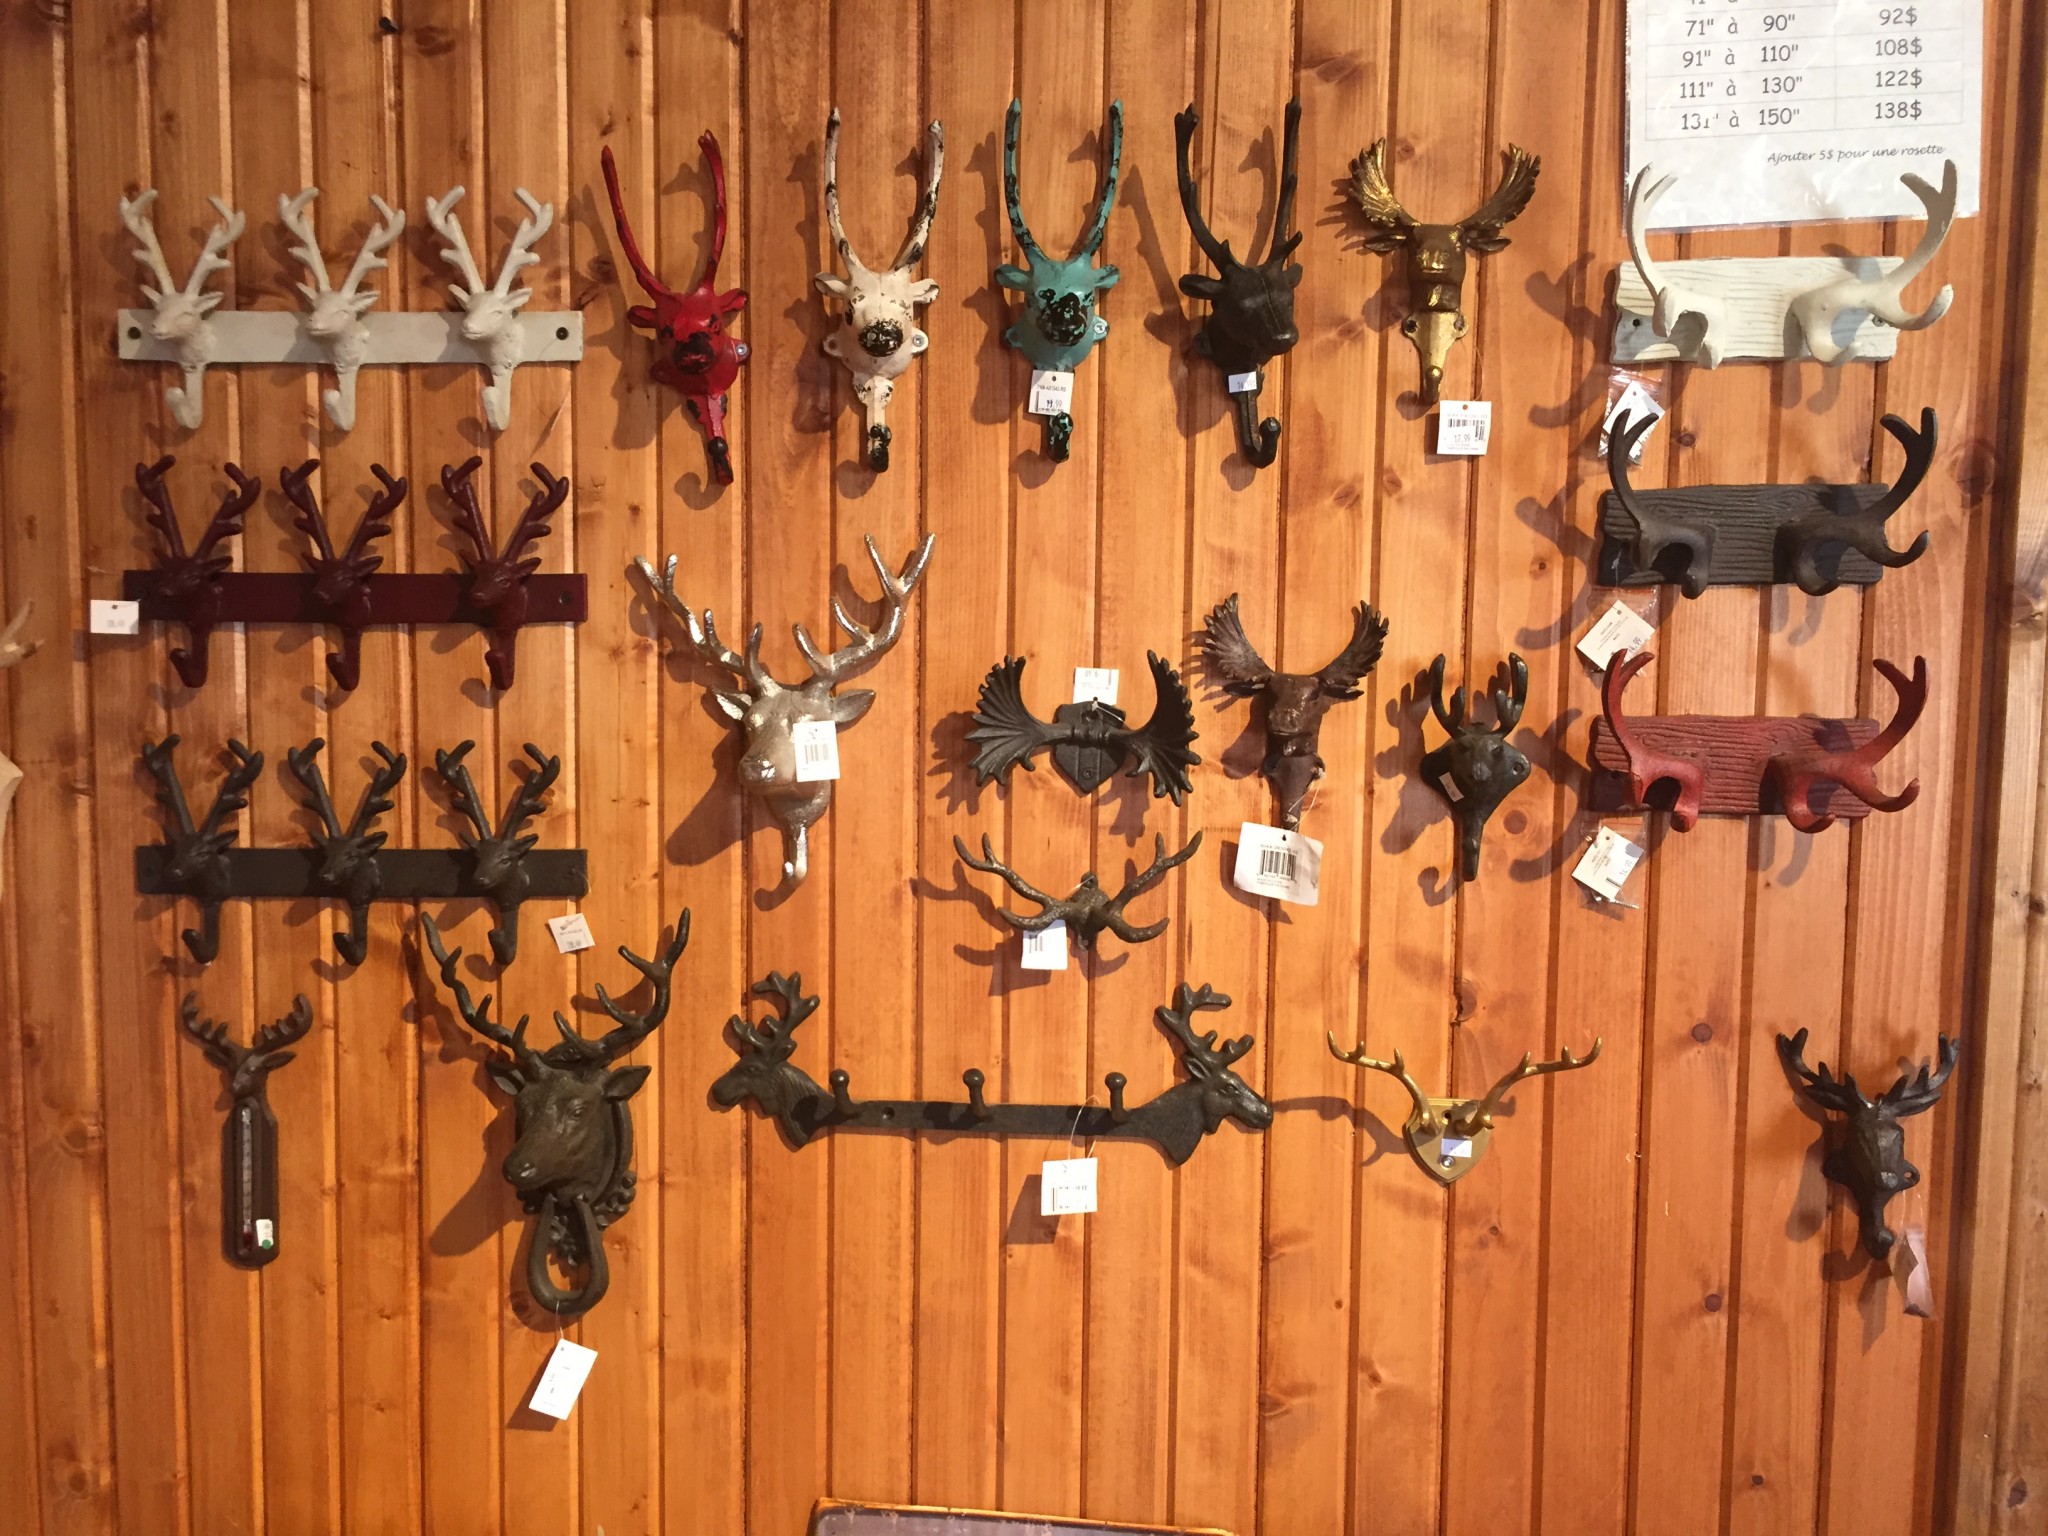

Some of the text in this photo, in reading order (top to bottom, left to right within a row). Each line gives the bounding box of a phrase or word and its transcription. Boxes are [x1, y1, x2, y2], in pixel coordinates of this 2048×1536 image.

[1685, 5, 1918, 37] 71" à 90" 92$
[1682, 36, 1923, 69] 91" à 110" 108$
[1679, 67, 1923, 99] 111" à 130" 122$
[1728, 110, 1740, 128] à
[1759, 107, 1800, 126] 150"
[1875, 99, 1923, 121] 138$
[1767, 144, 1946, 166] Ajouter 5$ pour une rosette
